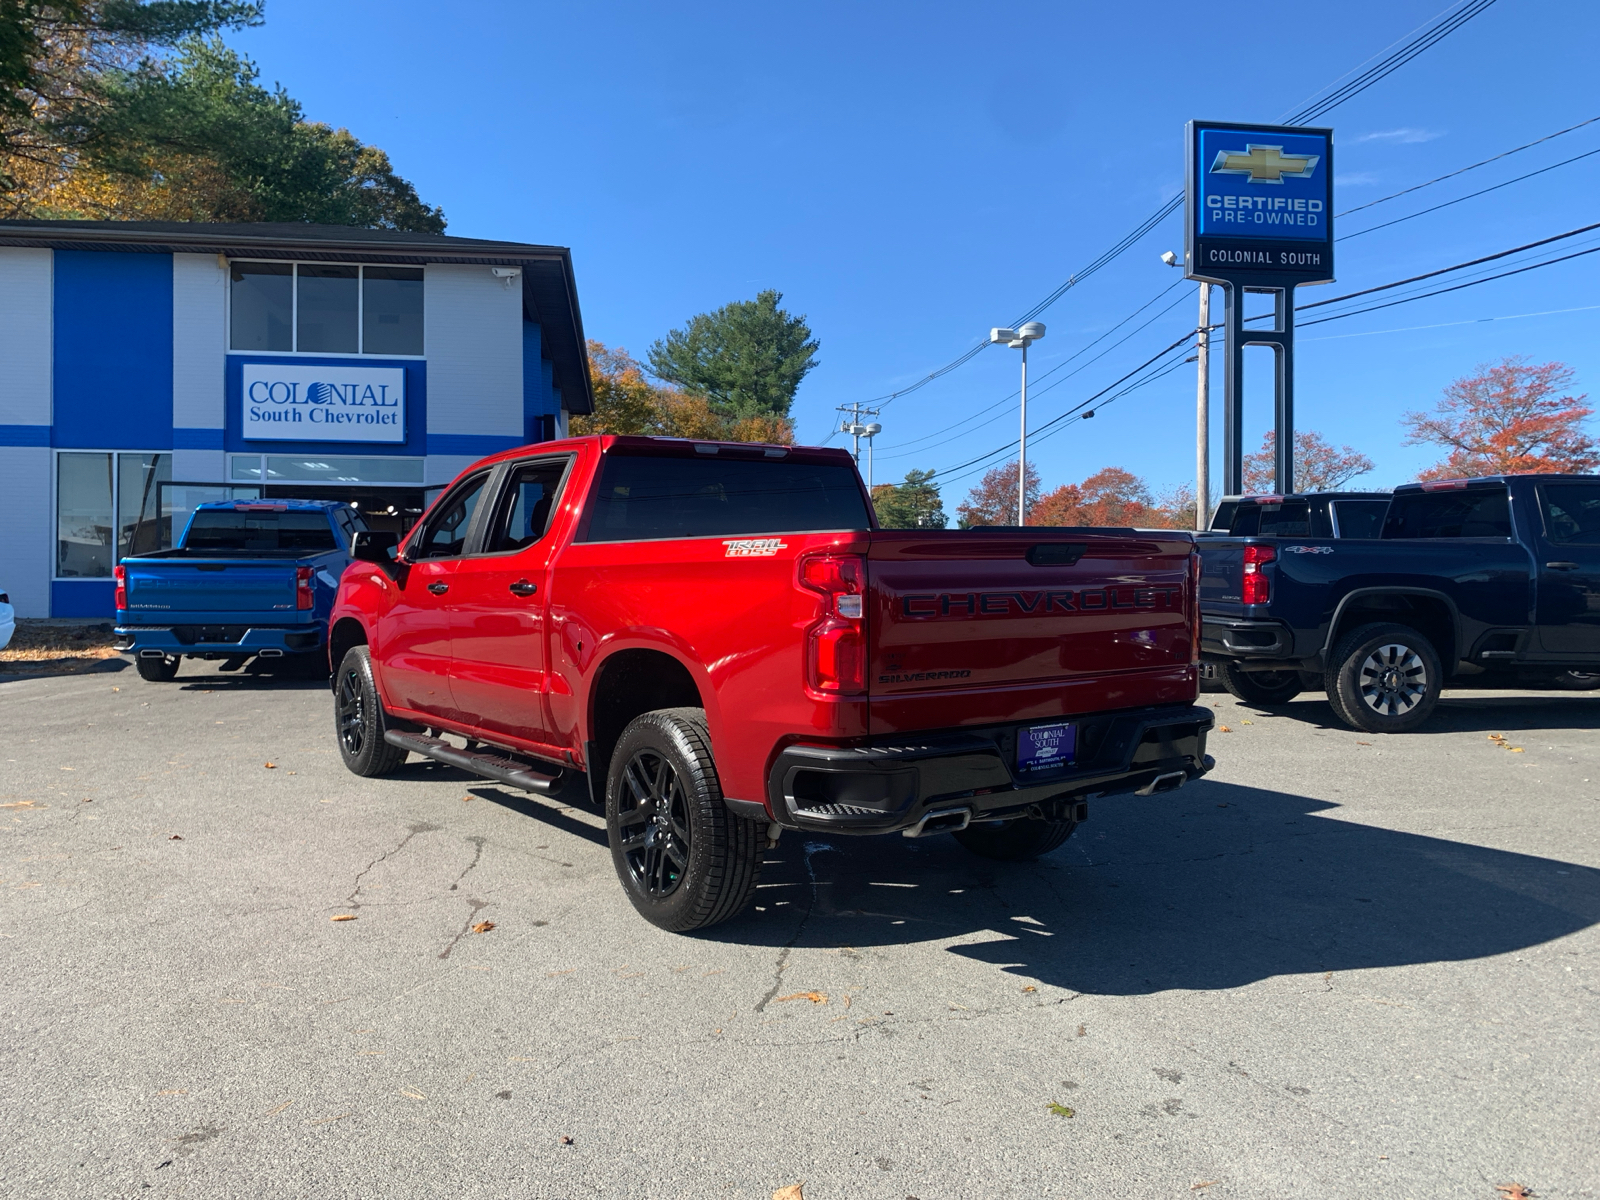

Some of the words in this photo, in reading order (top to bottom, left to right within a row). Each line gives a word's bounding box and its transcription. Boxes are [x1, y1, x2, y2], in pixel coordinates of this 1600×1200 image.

[1206, 194, 1323, 212] CERTIFIED
[1212, 210, 1318, 226] PRE-OWNED
[1210, 249, 1273, 264] COLONIAL
[1280, 252, 1321, 265] SOUTH
[249, 380, 398, 407] COLONIAL
[250, 406, 302, 422] South
[308, 407, 398, 425] Chevrolet
[722, 538, 788, 549] TRAIL
[725, 548, 778, 557] BOSS
[903, 586, 1180, 617] CHEVROLET
[878, 669, 972, 684] SILVERADO
[1030, 729, 1065, 740] COLONIAL
[1035, 738, 1059, 748] SOUTH
